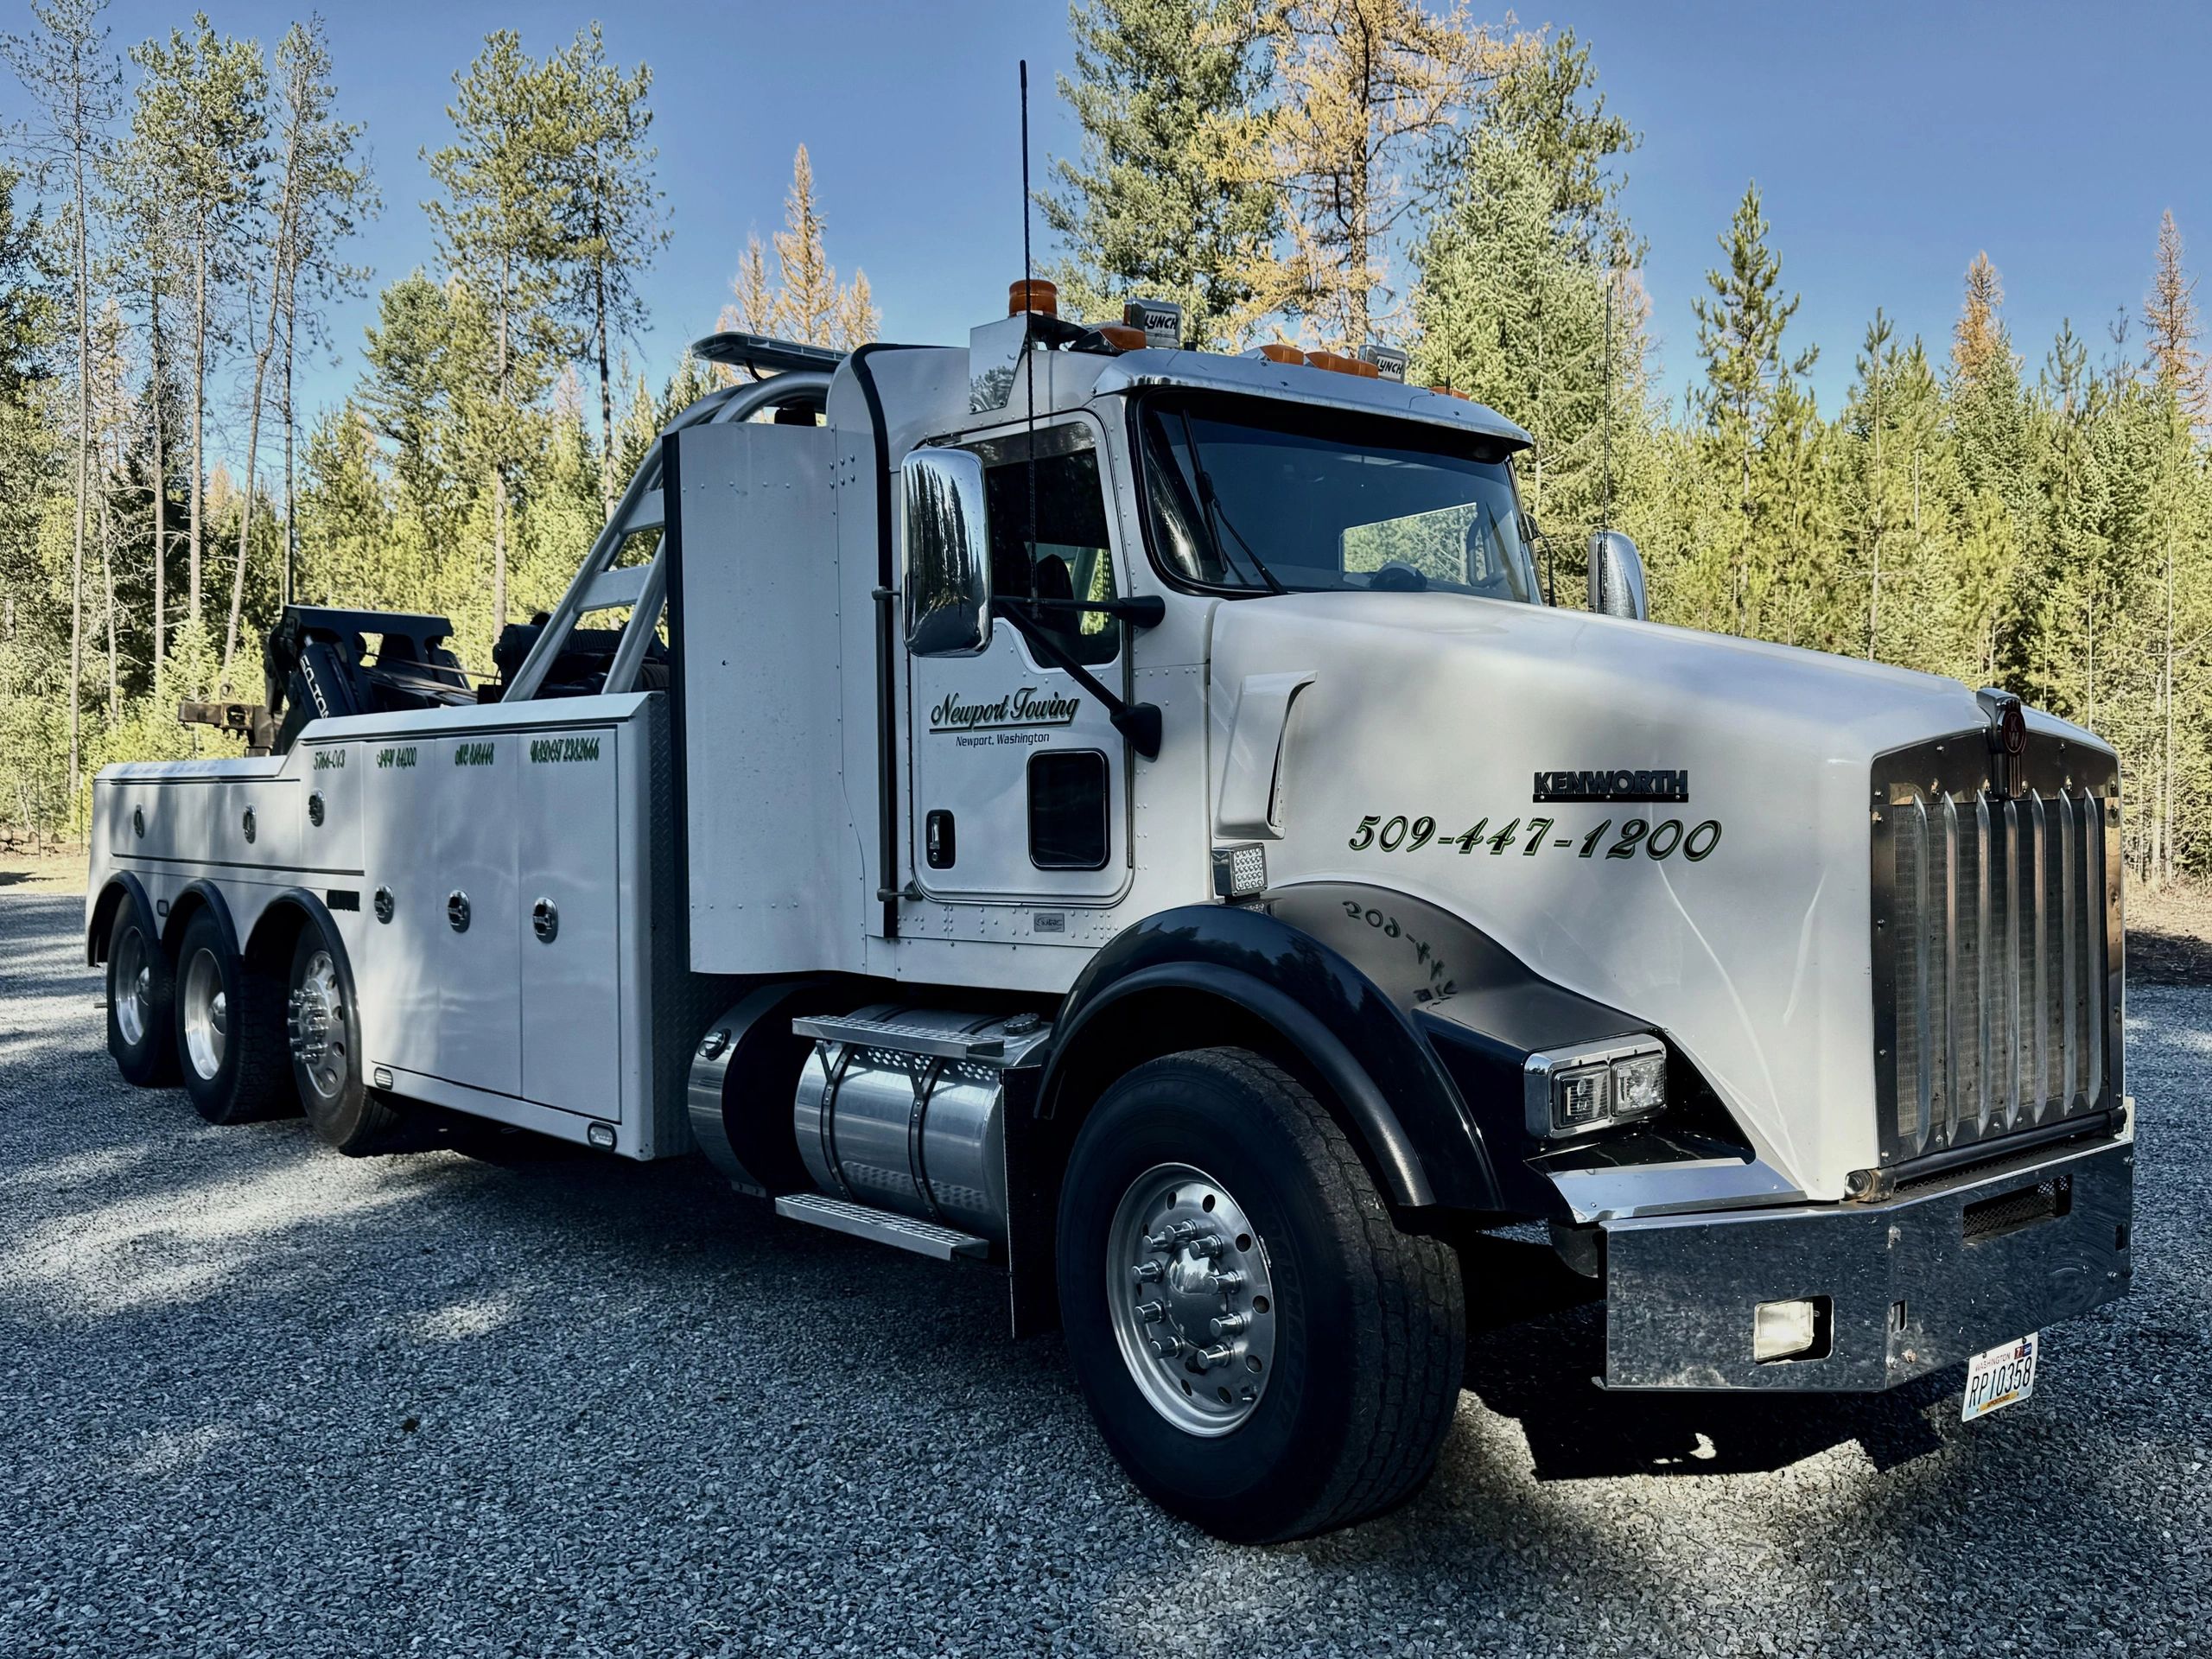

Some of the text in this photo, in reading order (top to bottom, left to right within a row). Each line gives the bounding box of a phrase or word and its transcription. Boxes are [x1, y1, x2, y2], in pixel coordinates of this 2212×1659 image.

[1145, 314, 1179, 330] LYNCH
[1376, 358, 1403, 375] LYNCH
[931, 686, 1080, 731] Newport Towing
[996, 733, 1050, 746] Washington
[1534, 770, 1688, 795] KENWORTH
[1348, 815, 1722, 862] 509-447-1200
[1975, 1352, 2011, 1372] WASHINGTON
[1968, 1356, 2032, 1408] RP10358
